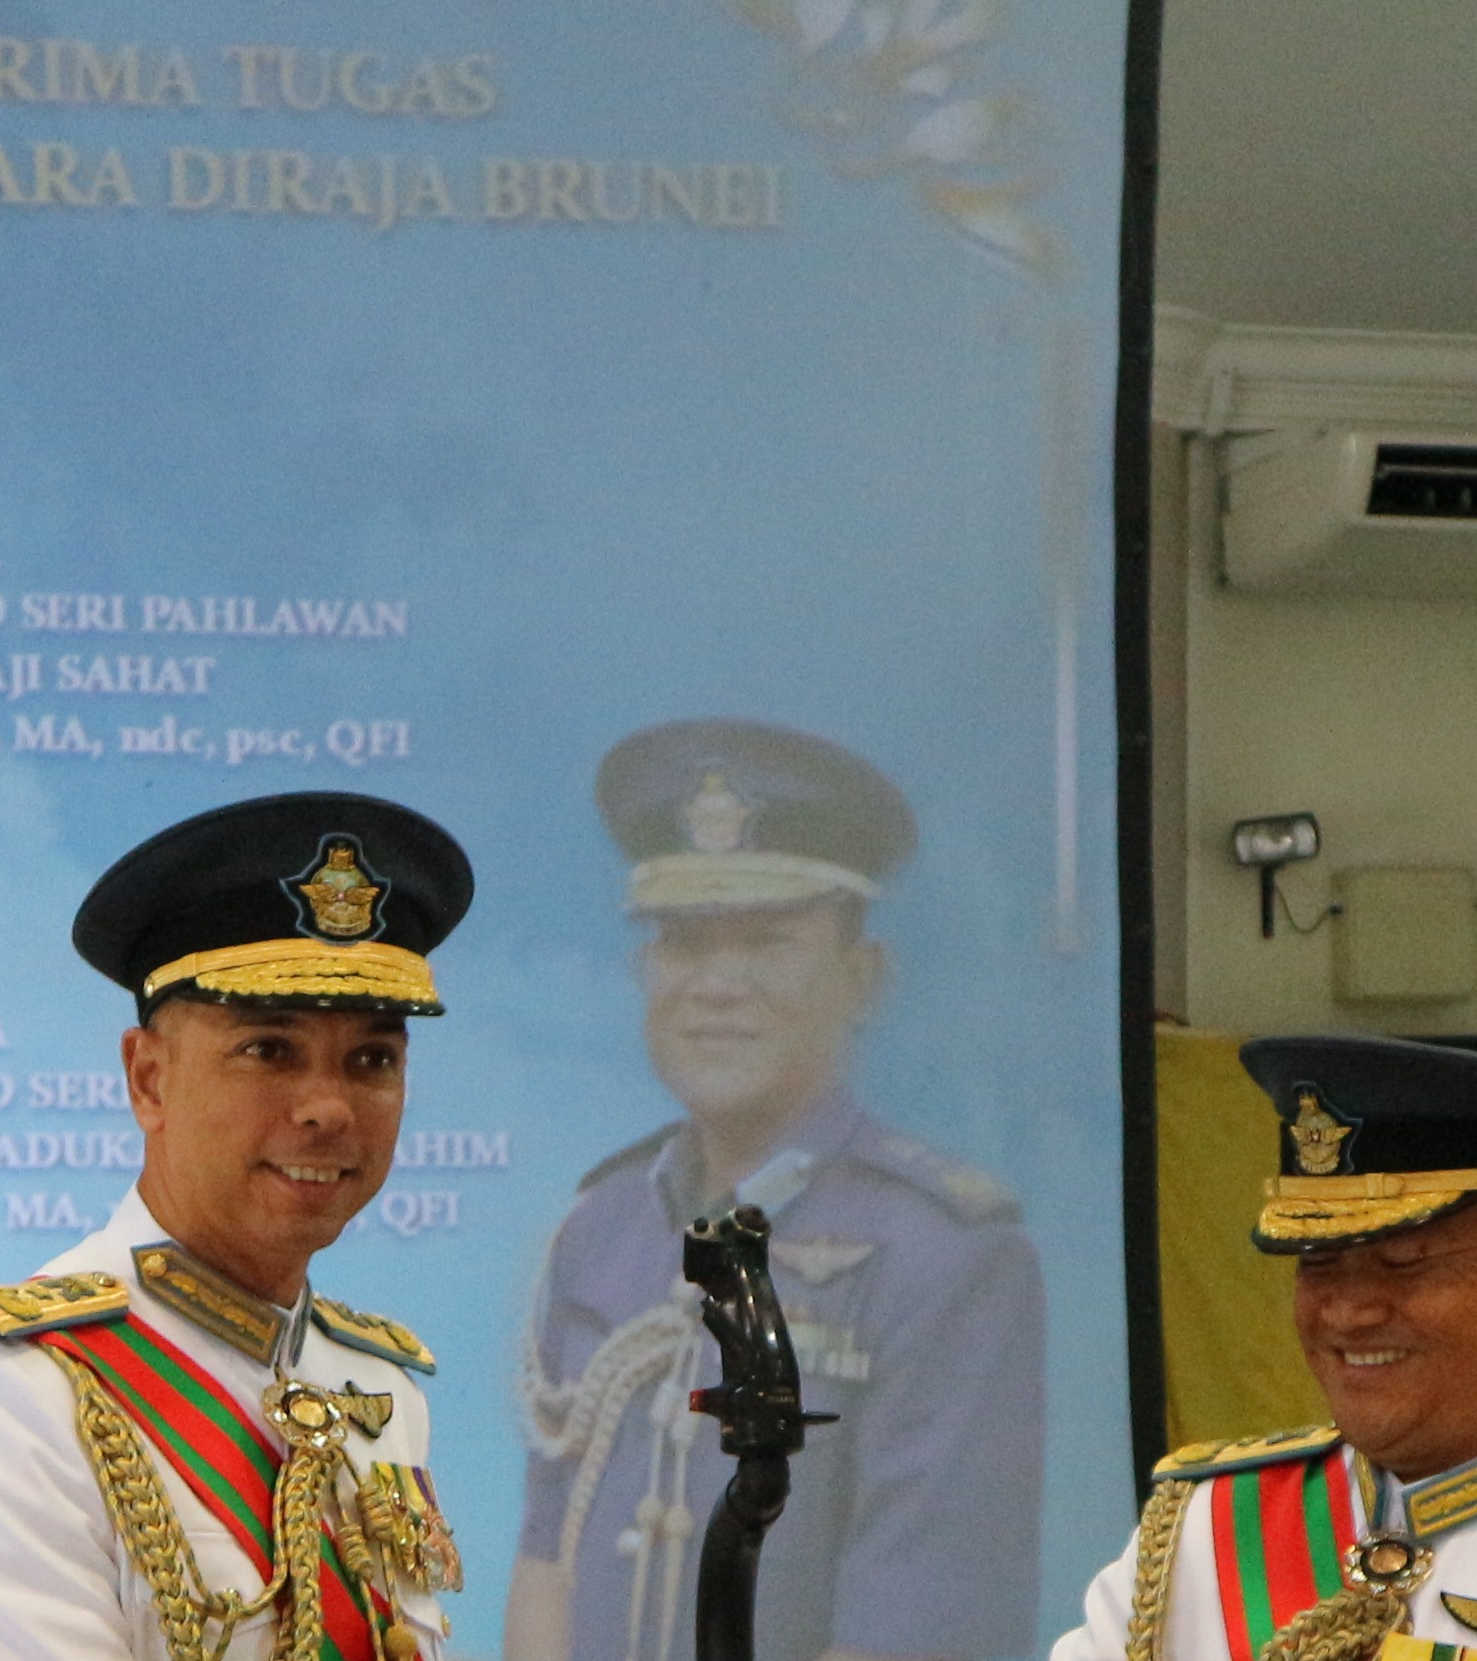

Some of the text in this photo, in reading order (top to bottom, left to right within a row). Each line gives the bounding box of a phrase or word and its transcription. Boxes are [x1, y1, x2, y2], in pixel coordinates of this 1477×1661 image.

[221, 44, 497, 118] TUGAS
[164, 146, 452, 232] DIRAJA
[479, 159, 784, 229] BRUNEI
[23, 595, 125, 632] SERI
[142, 597, 408, 637] PAHLAWAN
[58, 656, 216, 694] SAHAT
[326, 720, 410, 765] QFI
[382, 1191, 459, 1236] QFI
